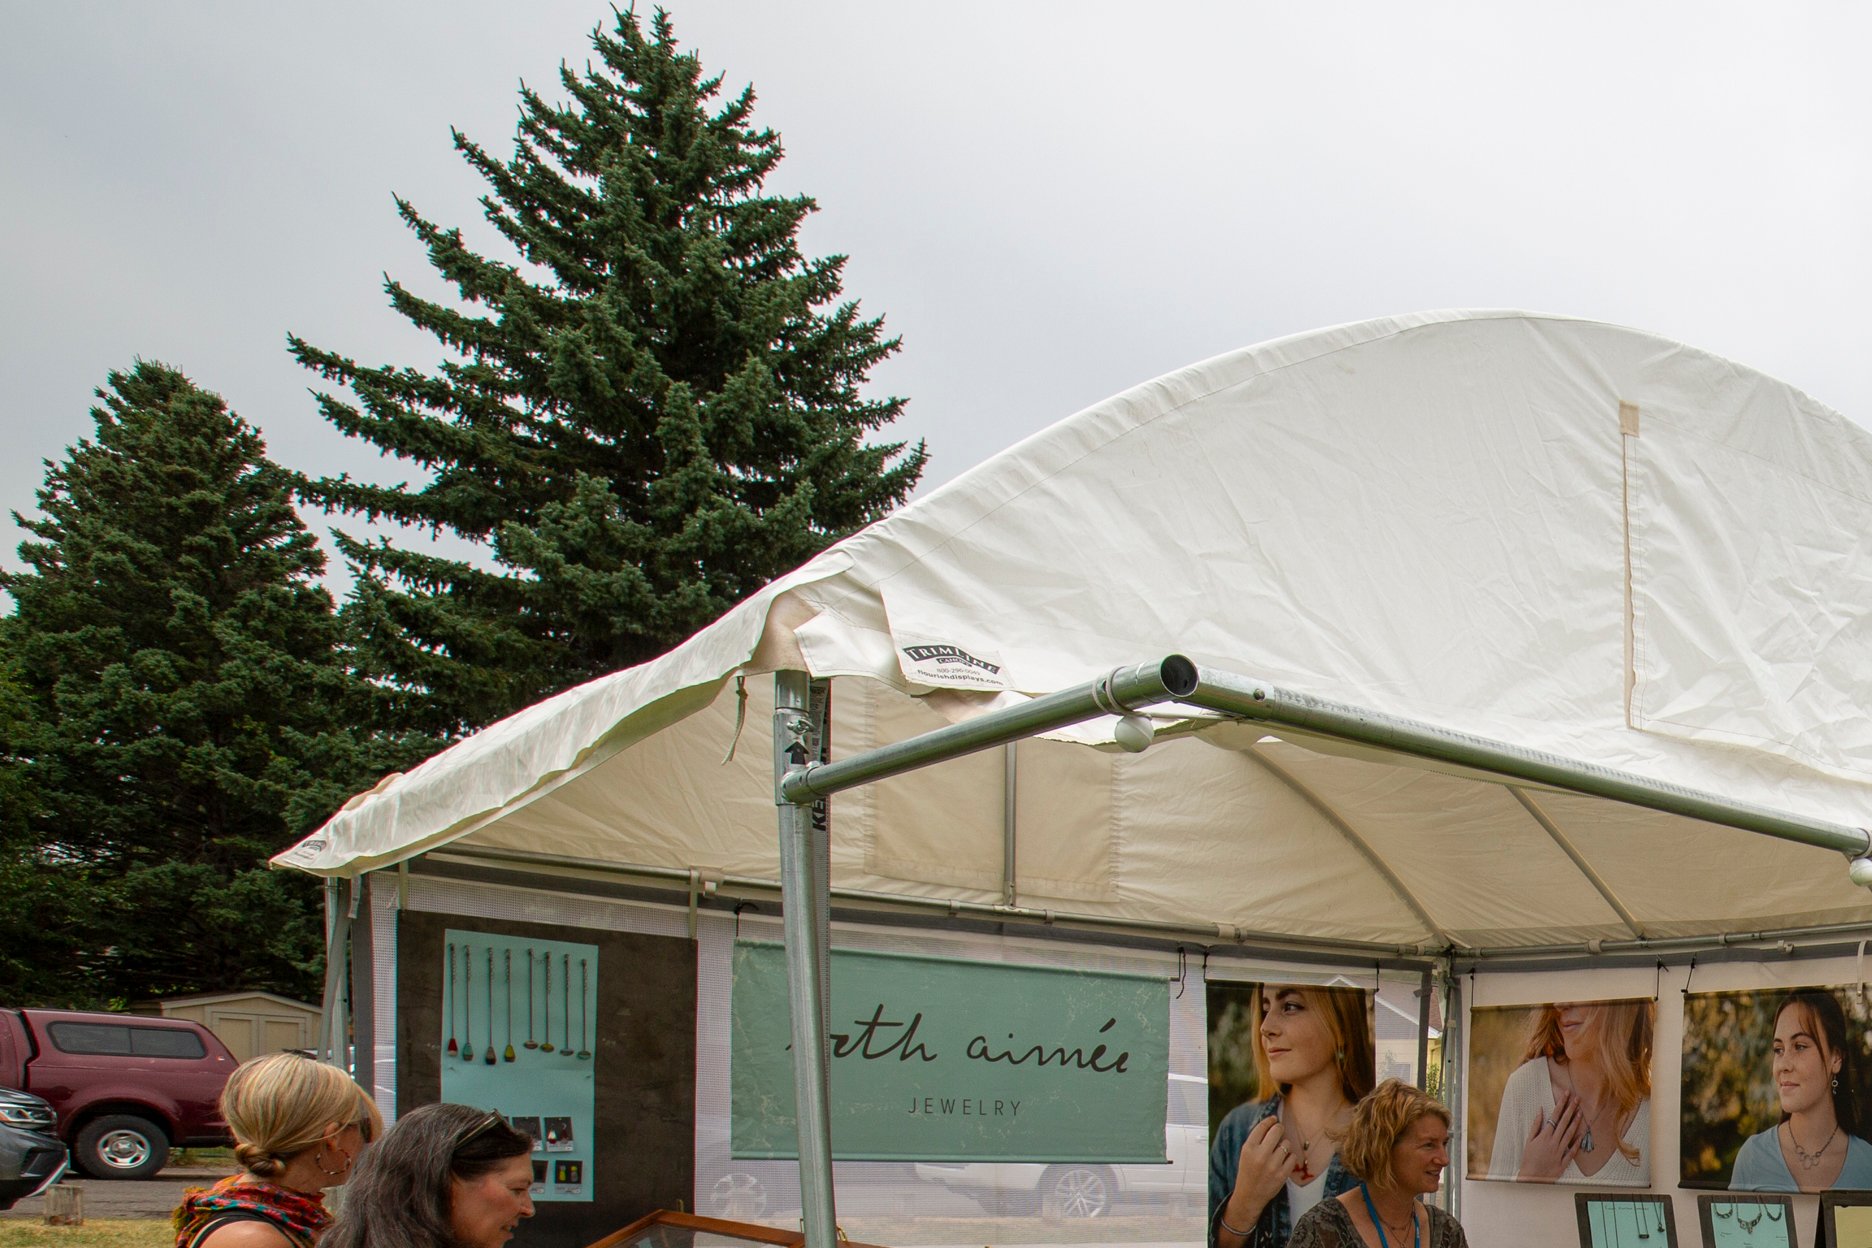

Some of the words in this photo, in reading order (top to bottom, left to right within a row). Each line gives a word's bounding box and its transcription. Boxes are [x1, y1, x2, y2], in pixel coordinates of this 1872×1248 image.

[917, 669, 1004, 686] flourishdisplays.com
[966, 1018, 1128, 1074] aimée
[908, 1097, 1022, 1116] JEWELRY
